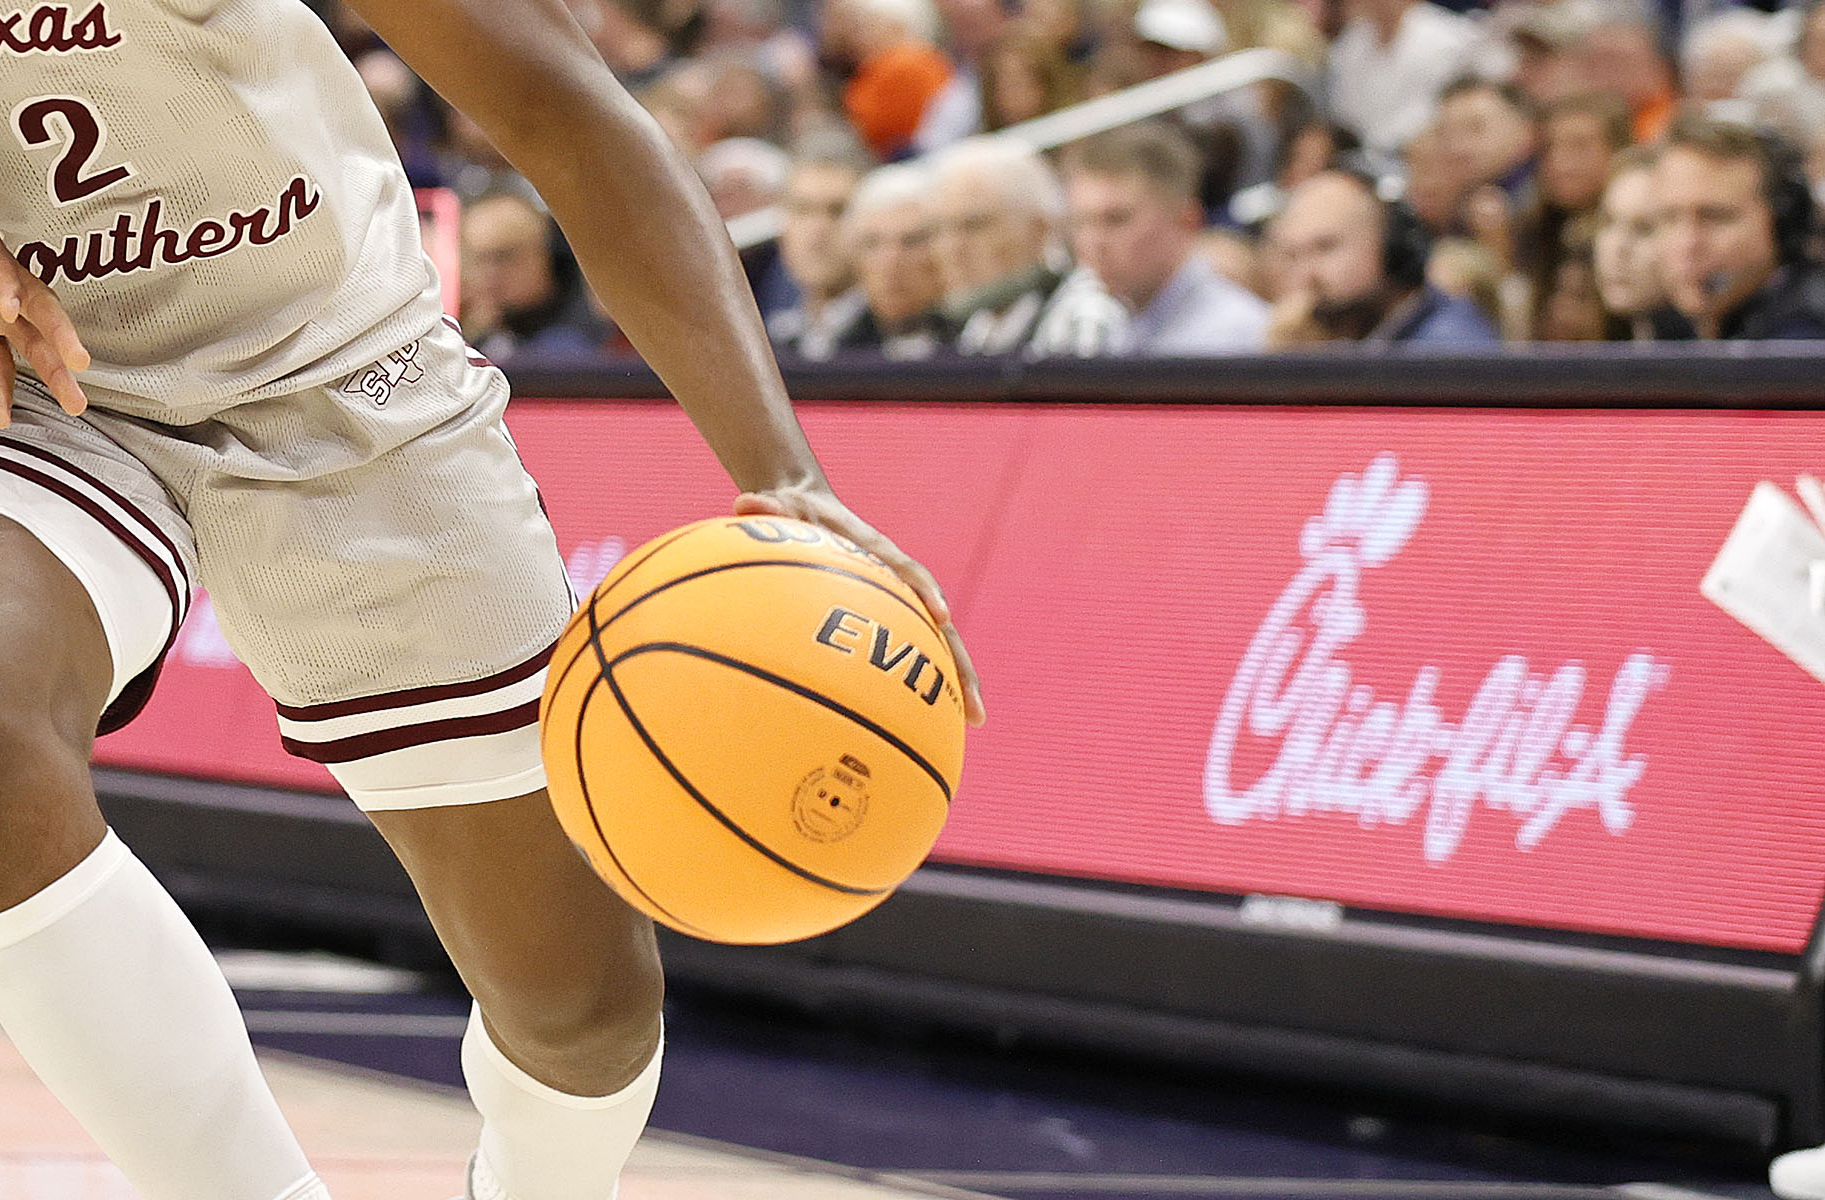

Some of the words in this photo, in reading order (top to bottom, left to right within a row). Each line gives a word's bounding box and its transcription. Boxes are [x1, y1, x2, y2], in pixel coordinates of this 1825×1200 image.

[12, 94, 134, 206] 2
[18, 174, 323, 287] outhern
[814, 605, 945, 706] EVO
